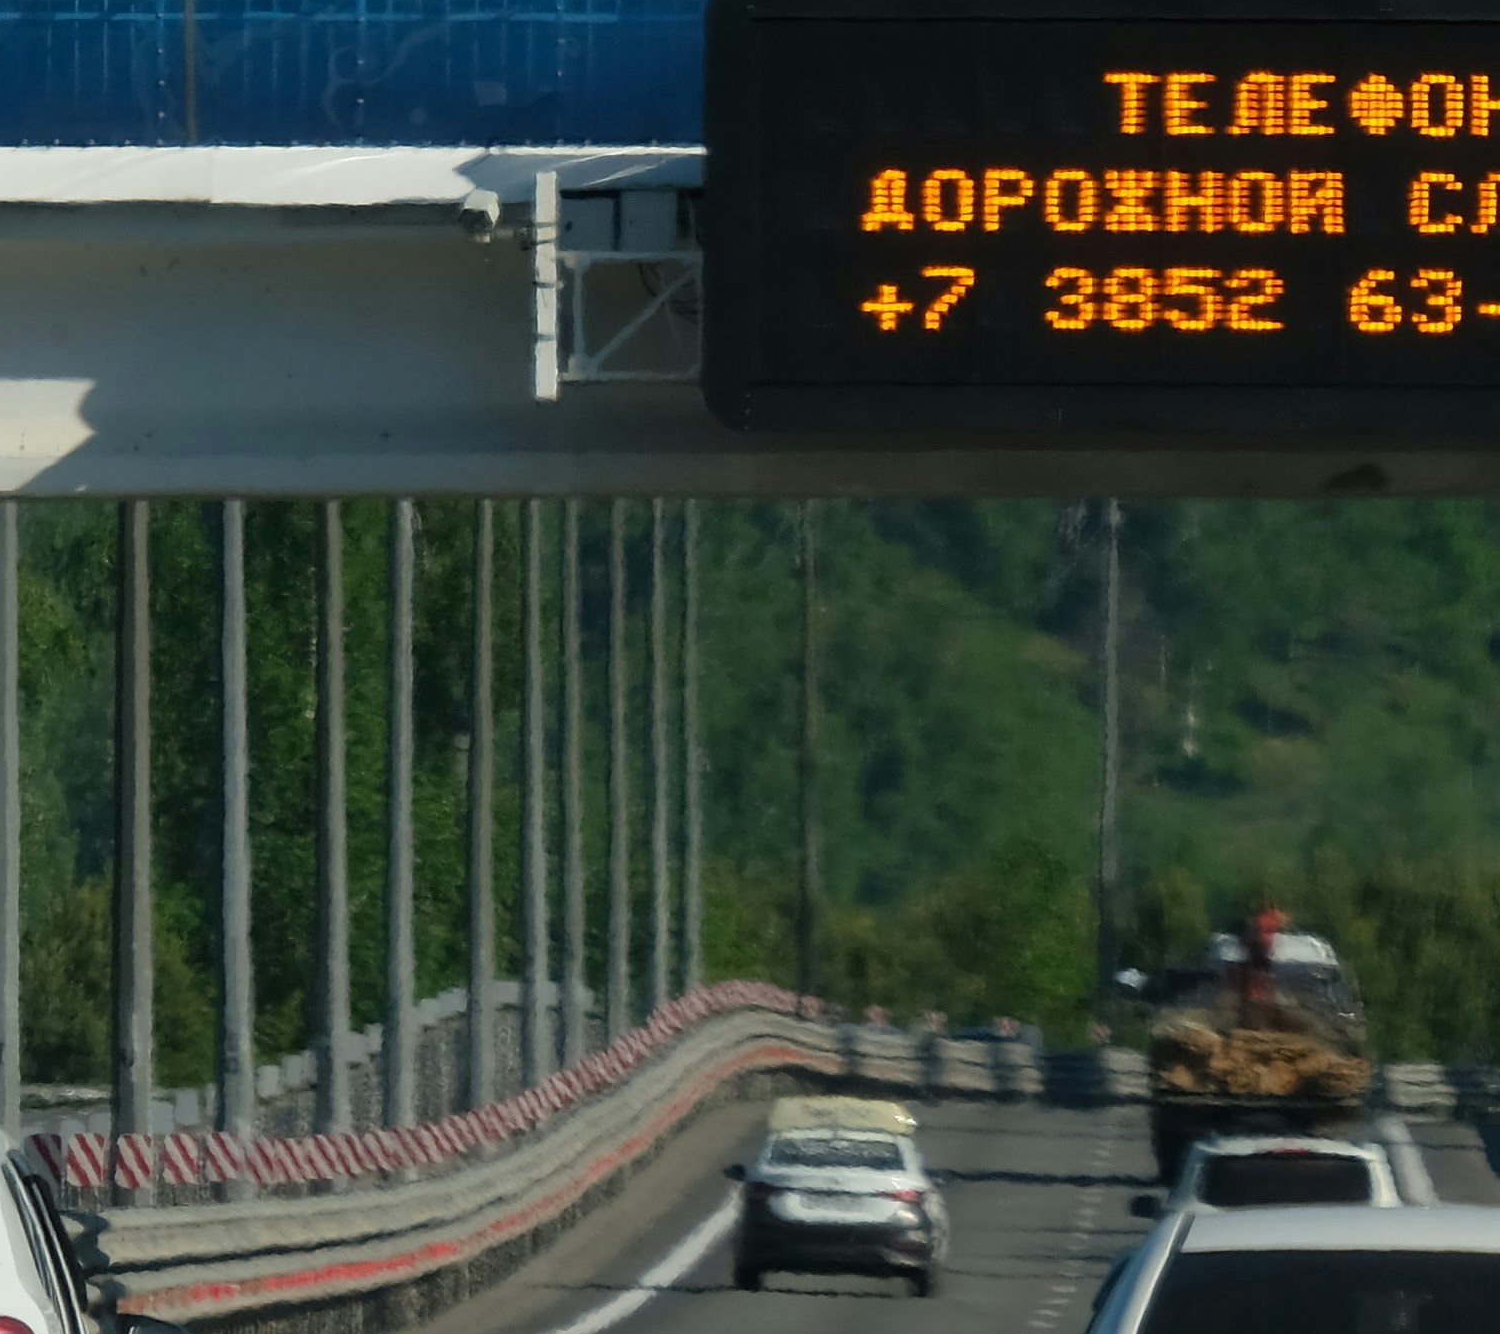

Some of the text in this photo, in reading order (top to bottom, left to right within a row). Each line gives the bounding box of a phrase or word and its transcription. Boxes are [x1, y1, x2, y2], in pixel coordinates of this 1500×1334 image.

[860, 167, 1345, 236] ДОРОЖНОЙ
[860, 265, 975, 334] +7
[1043, 265, 1284, 334] 3852
